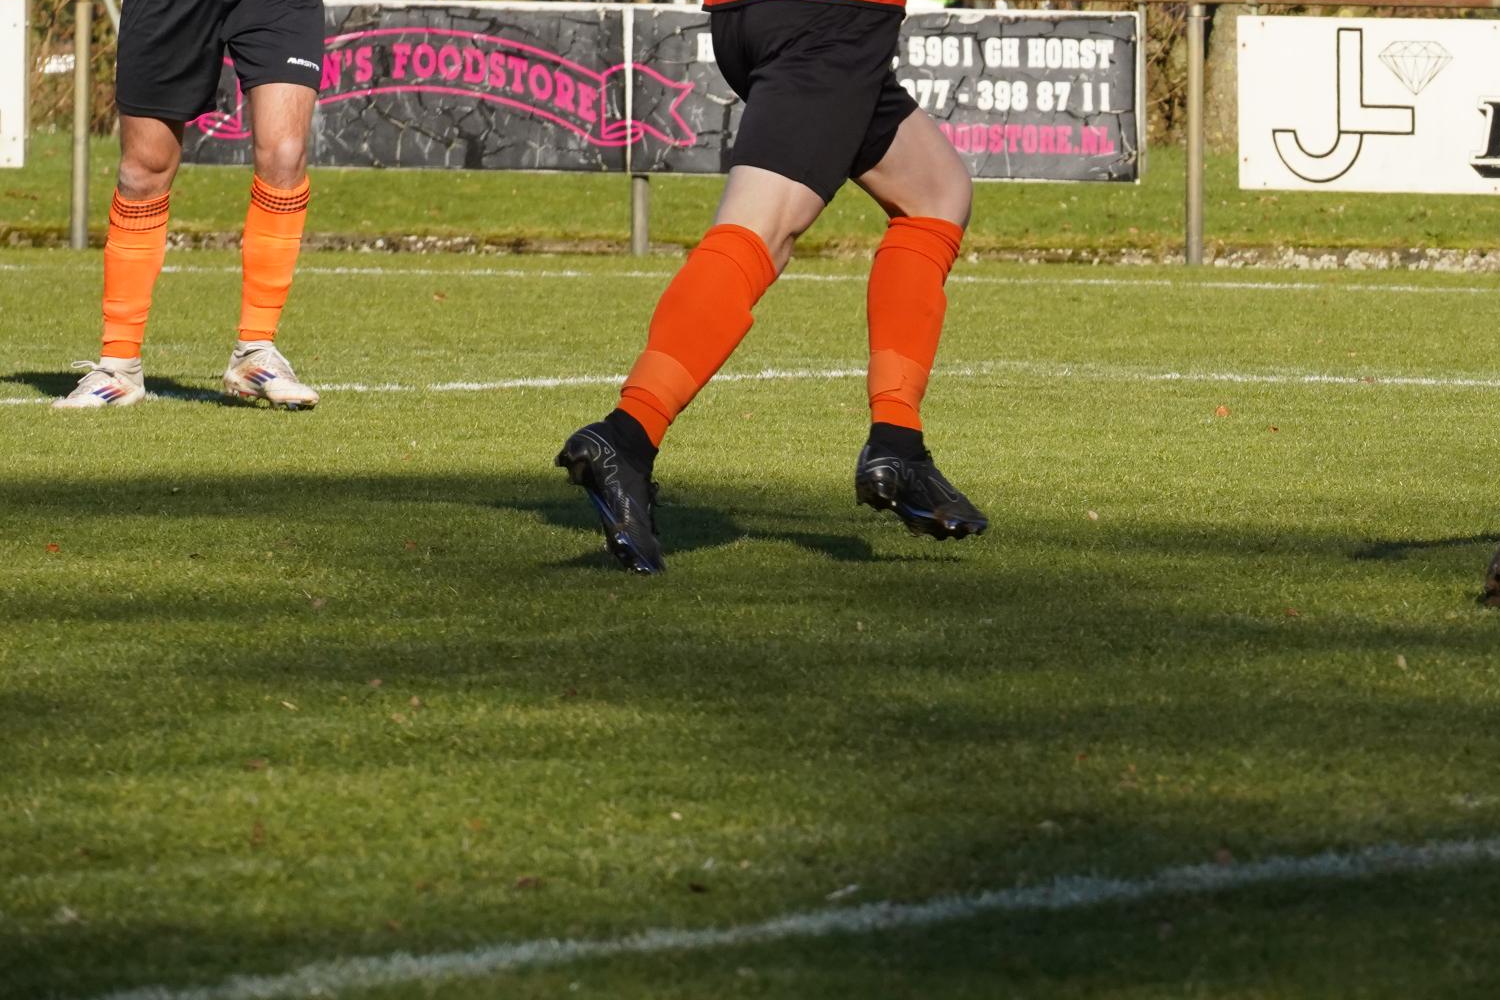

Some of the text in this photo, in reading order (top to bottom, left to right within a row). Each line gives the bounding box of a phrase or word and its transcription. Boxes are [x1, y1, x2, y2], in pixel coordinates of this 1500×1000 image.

[908, 37, 1115, 69] 5961 GH HORST
[320, 43, 597, 123] N'S FOODSTORE
[976, 80, 1029, 111] 398
[1036, 81, 1071, 111] 87
[1082, 82, 1110, 112] 11
